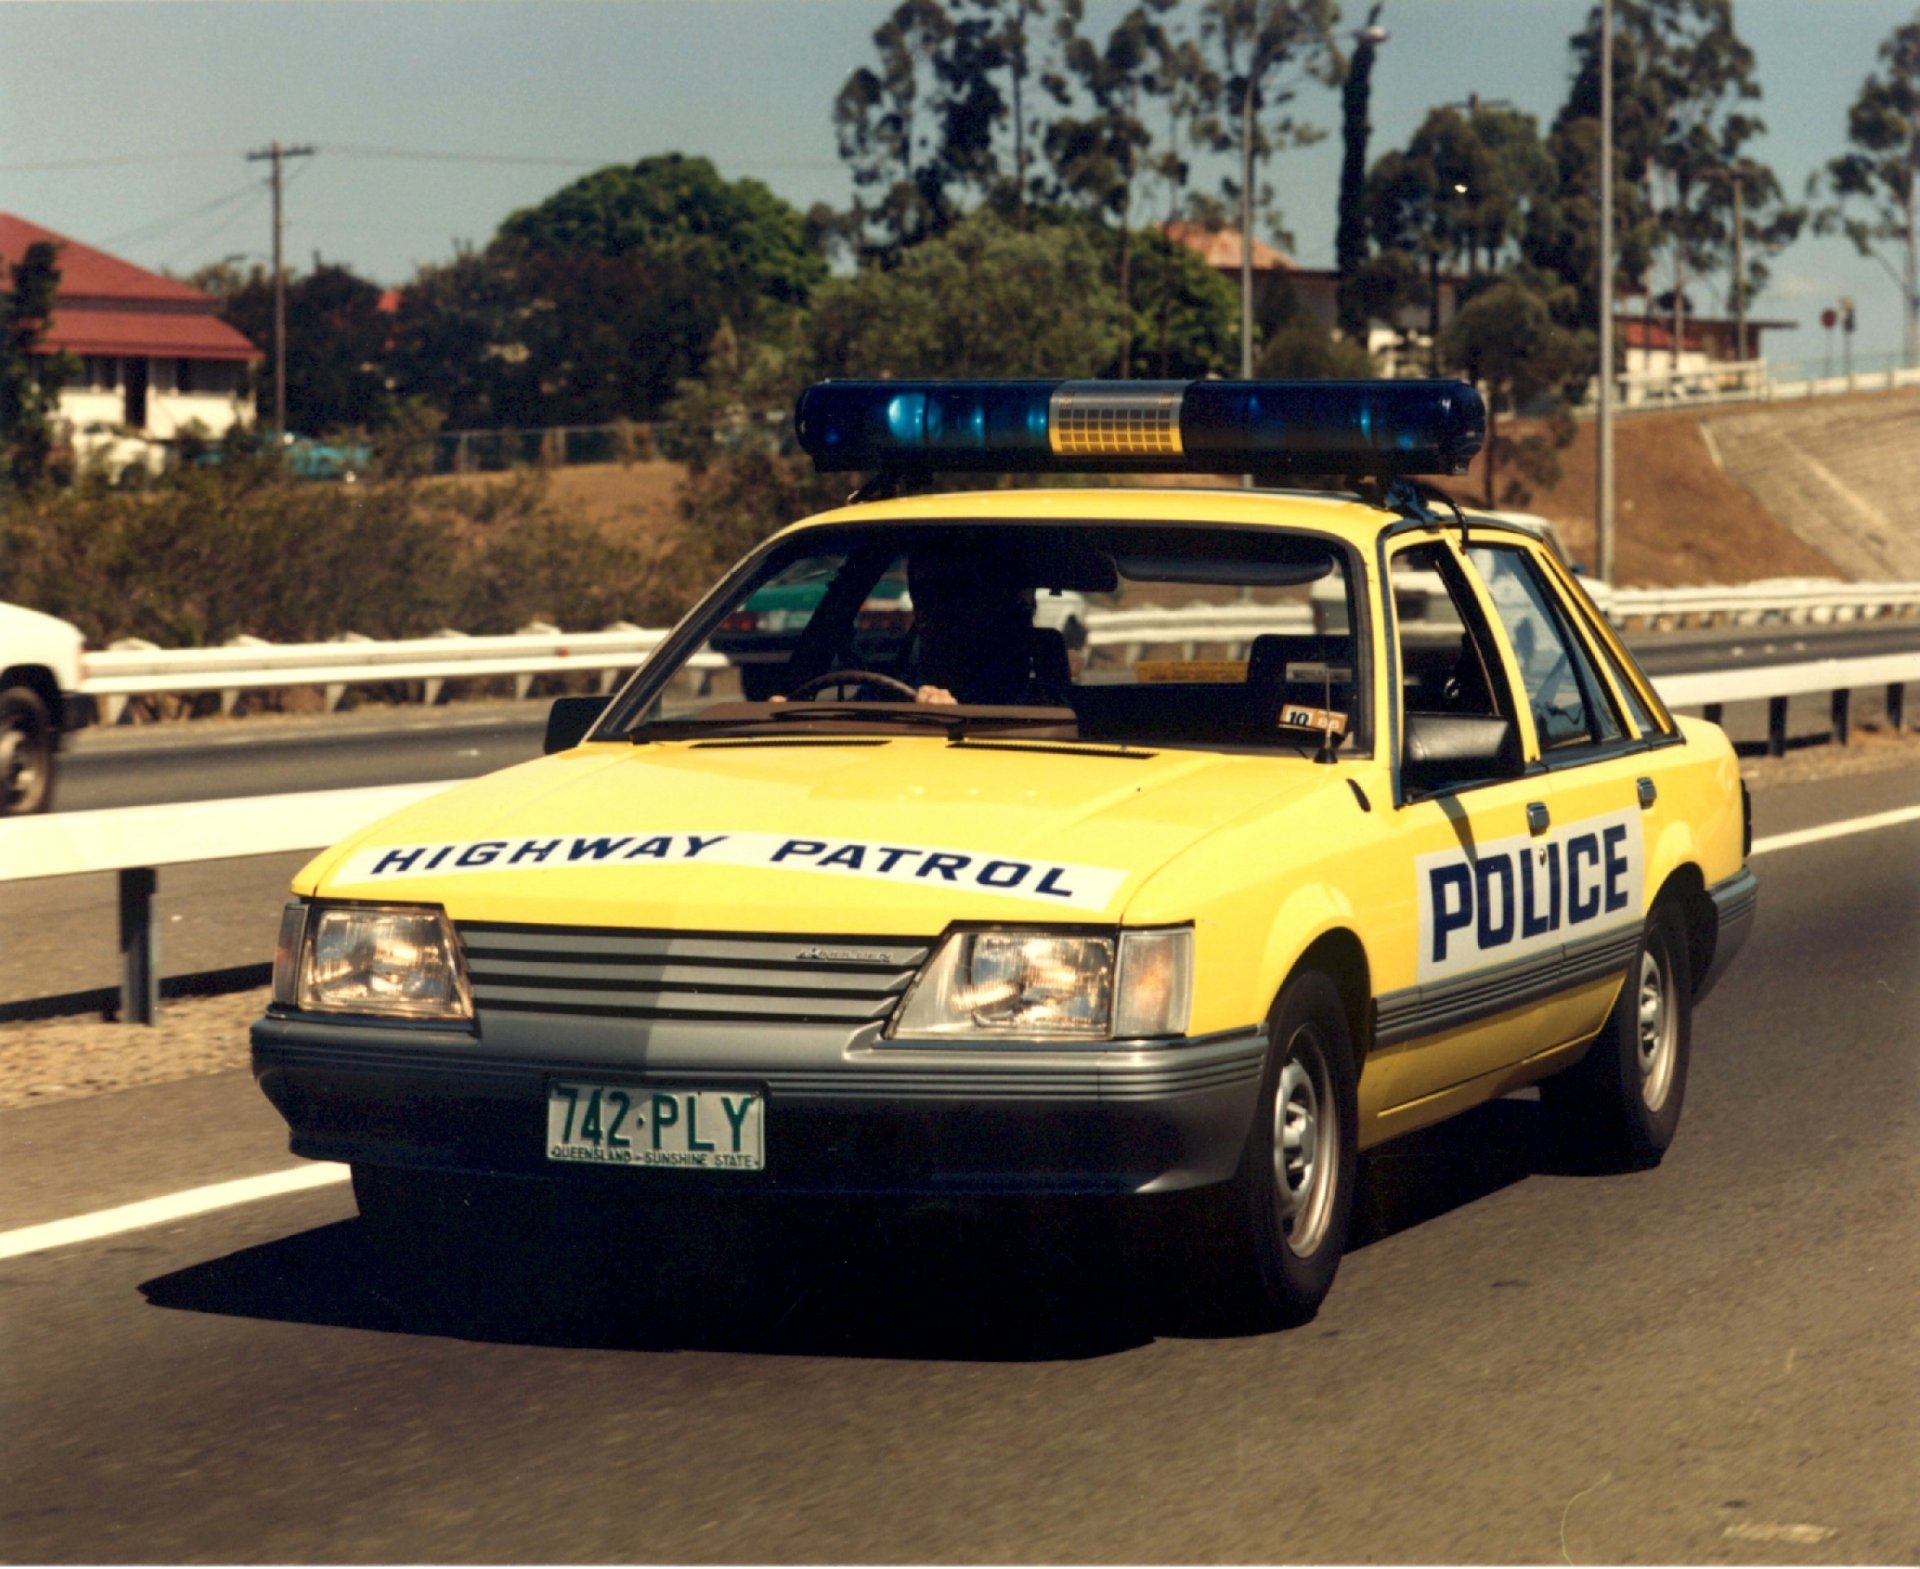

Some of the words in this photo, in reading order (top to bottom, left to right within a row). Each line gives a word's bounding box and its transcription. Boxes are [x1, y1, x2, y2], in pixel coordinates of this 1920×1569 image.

[1289, 711, 1310, 727] 10
[370, 835, 731, 874] HIGHWAY
[769, 839, 1074, 898] PATROL
[1429, 823, 1629, 963] POLICE
[552, 1145, 633, 1162] QUEENSLAND
[645, 1151, 708, 1166] SUNSHINE
[713, 1153, 753, 1167] STATE
